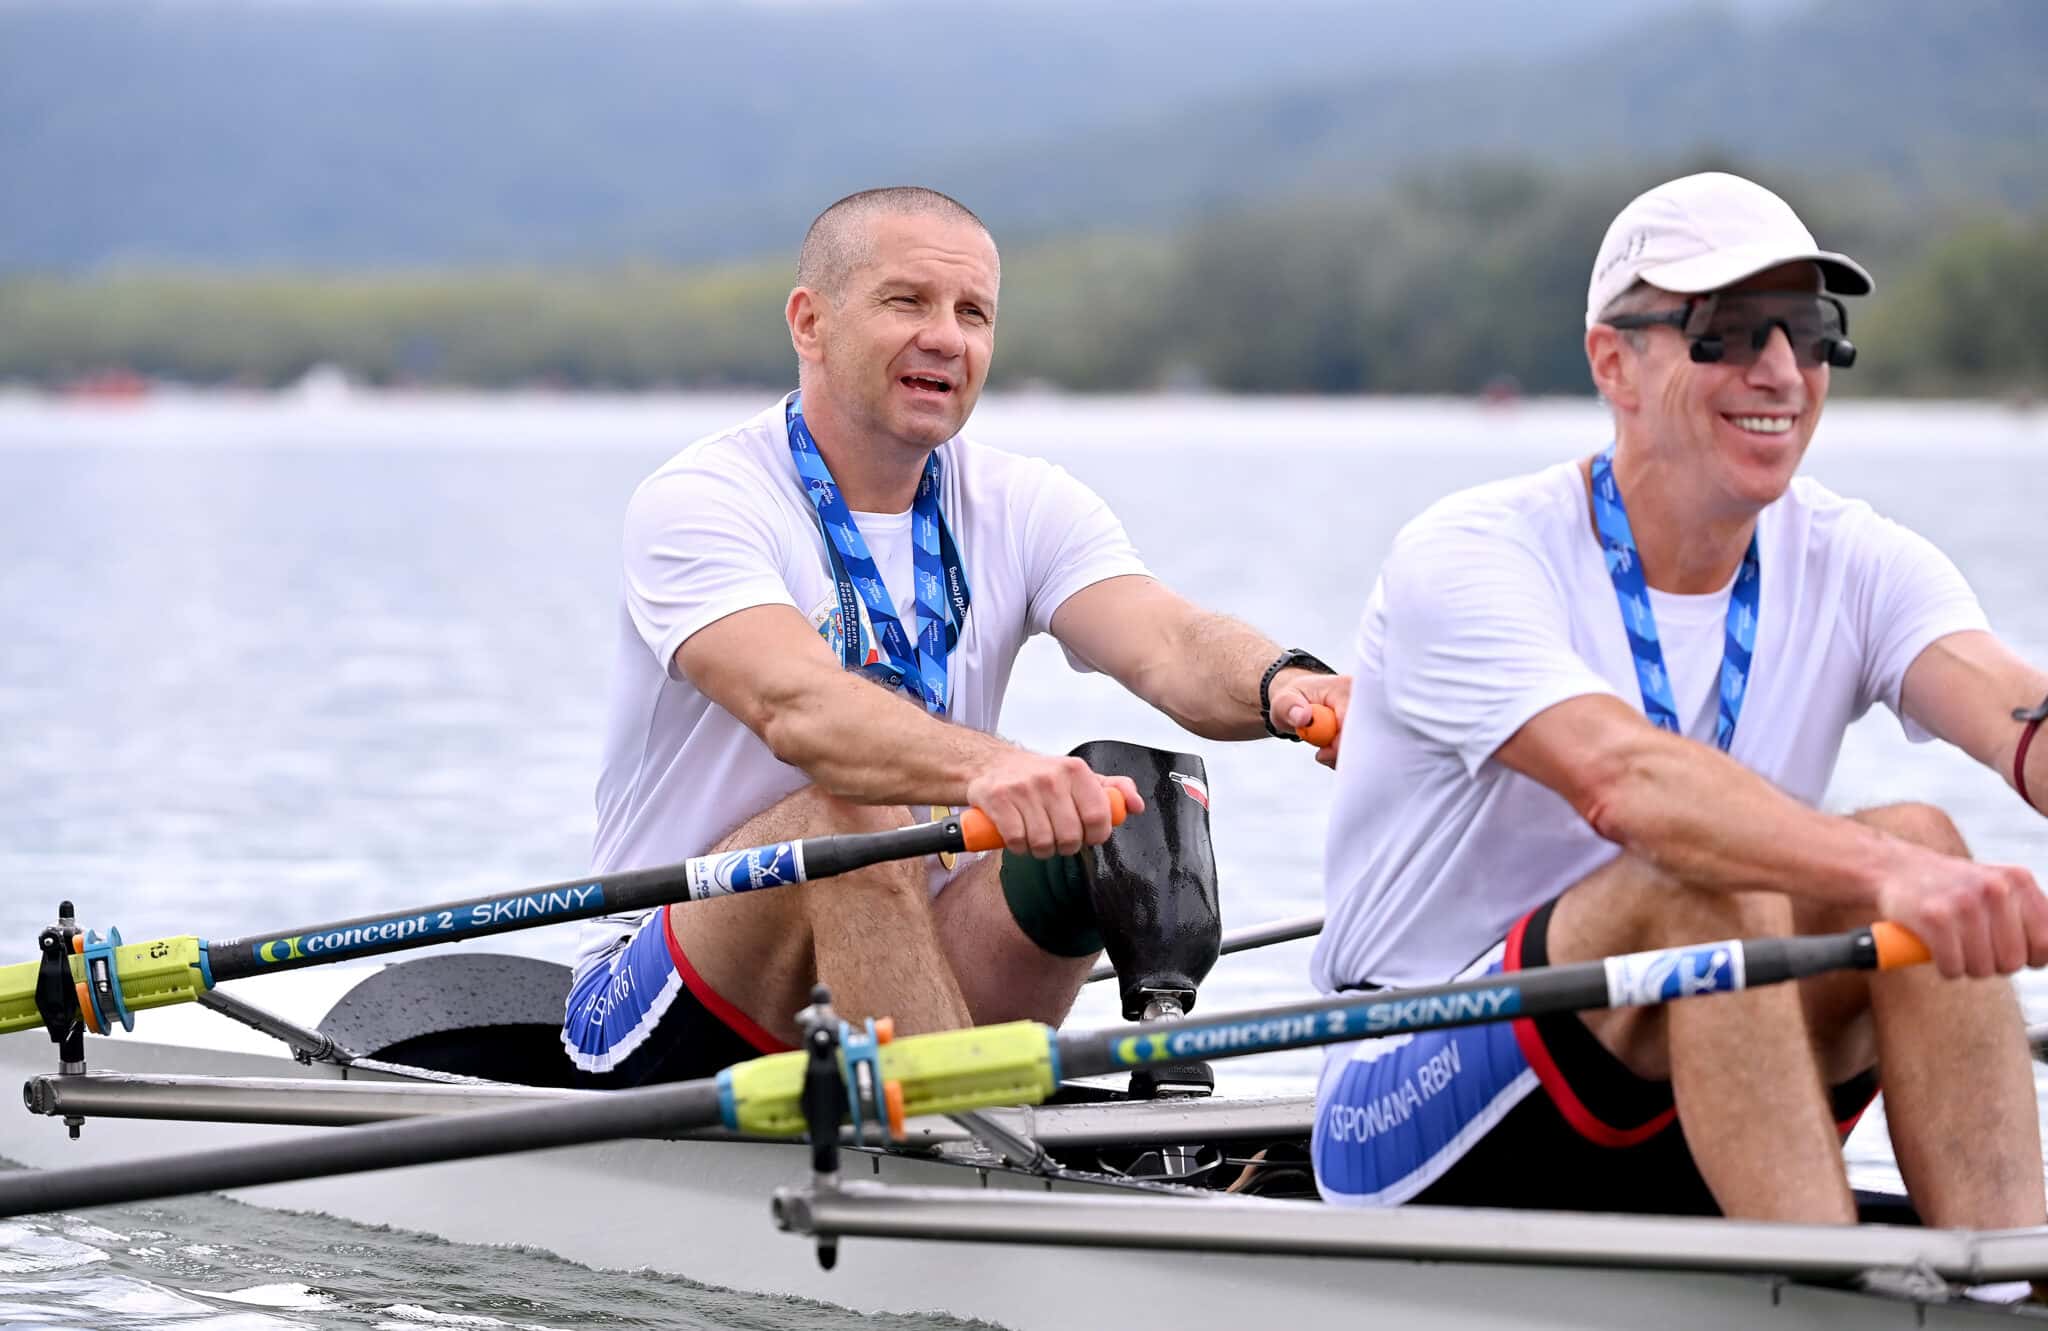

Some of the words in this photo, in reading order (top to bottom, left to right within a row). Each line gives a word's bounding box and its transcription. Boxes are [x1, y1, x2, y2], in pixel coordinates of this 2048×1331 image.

[306, 914, 428, 953] concept
[438, 912, 454, 930] 2
[471, 885, 595, 926] SKINNY
[1173, 1014, 1314, 1052] concept
[1327, 1012, 1347, 1035] 2
[1365, 987, 1513, 1030] SKINNY
